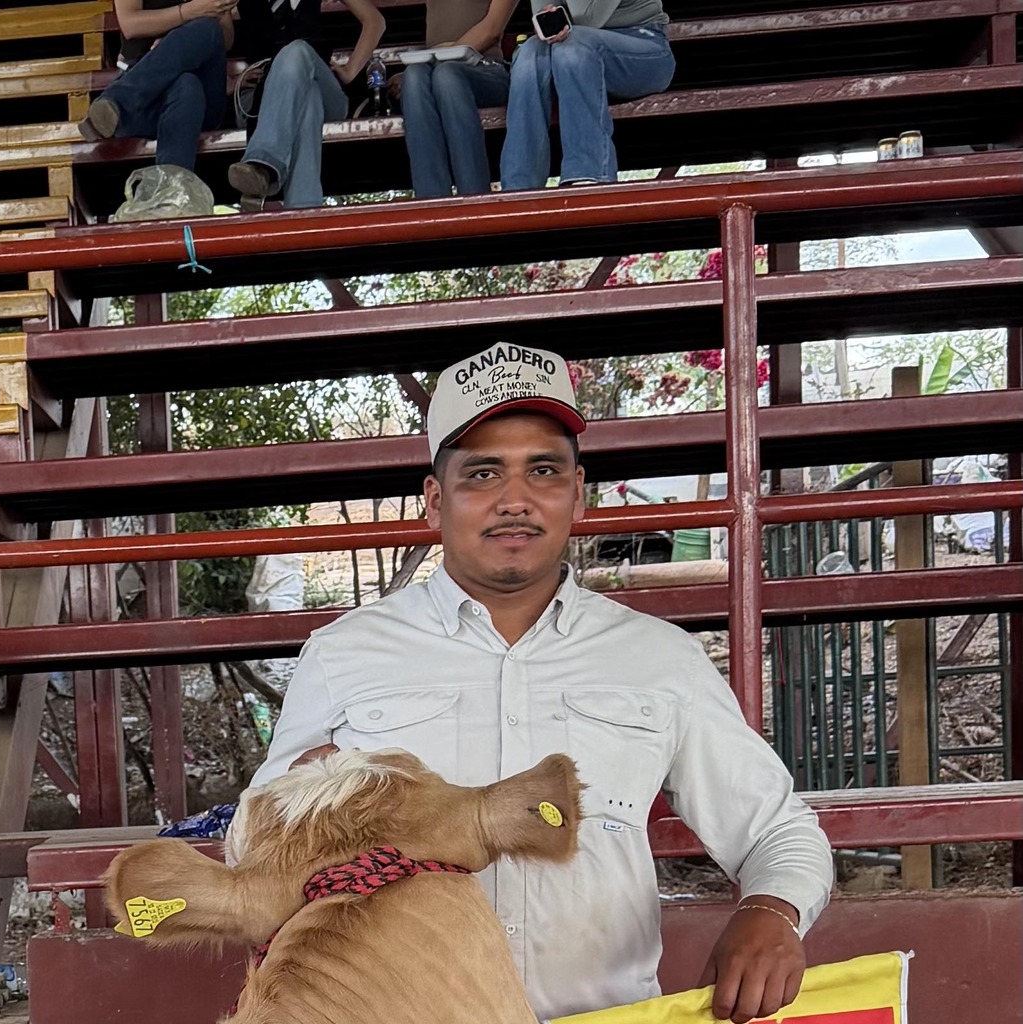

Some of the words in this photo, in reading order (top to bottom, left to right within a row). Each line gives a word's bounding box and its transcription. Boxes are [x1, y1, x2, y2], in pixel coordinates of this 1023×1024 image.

[455, 346, 556, 385] GANADERO
[488, 365, 522, 384] Beef
[479, 383, 504, 398] MEAT
[507, 381, 537, 390] MONEY
[475, 393, 499, 407] COWS
[128, 899, 154, 931] 7567
